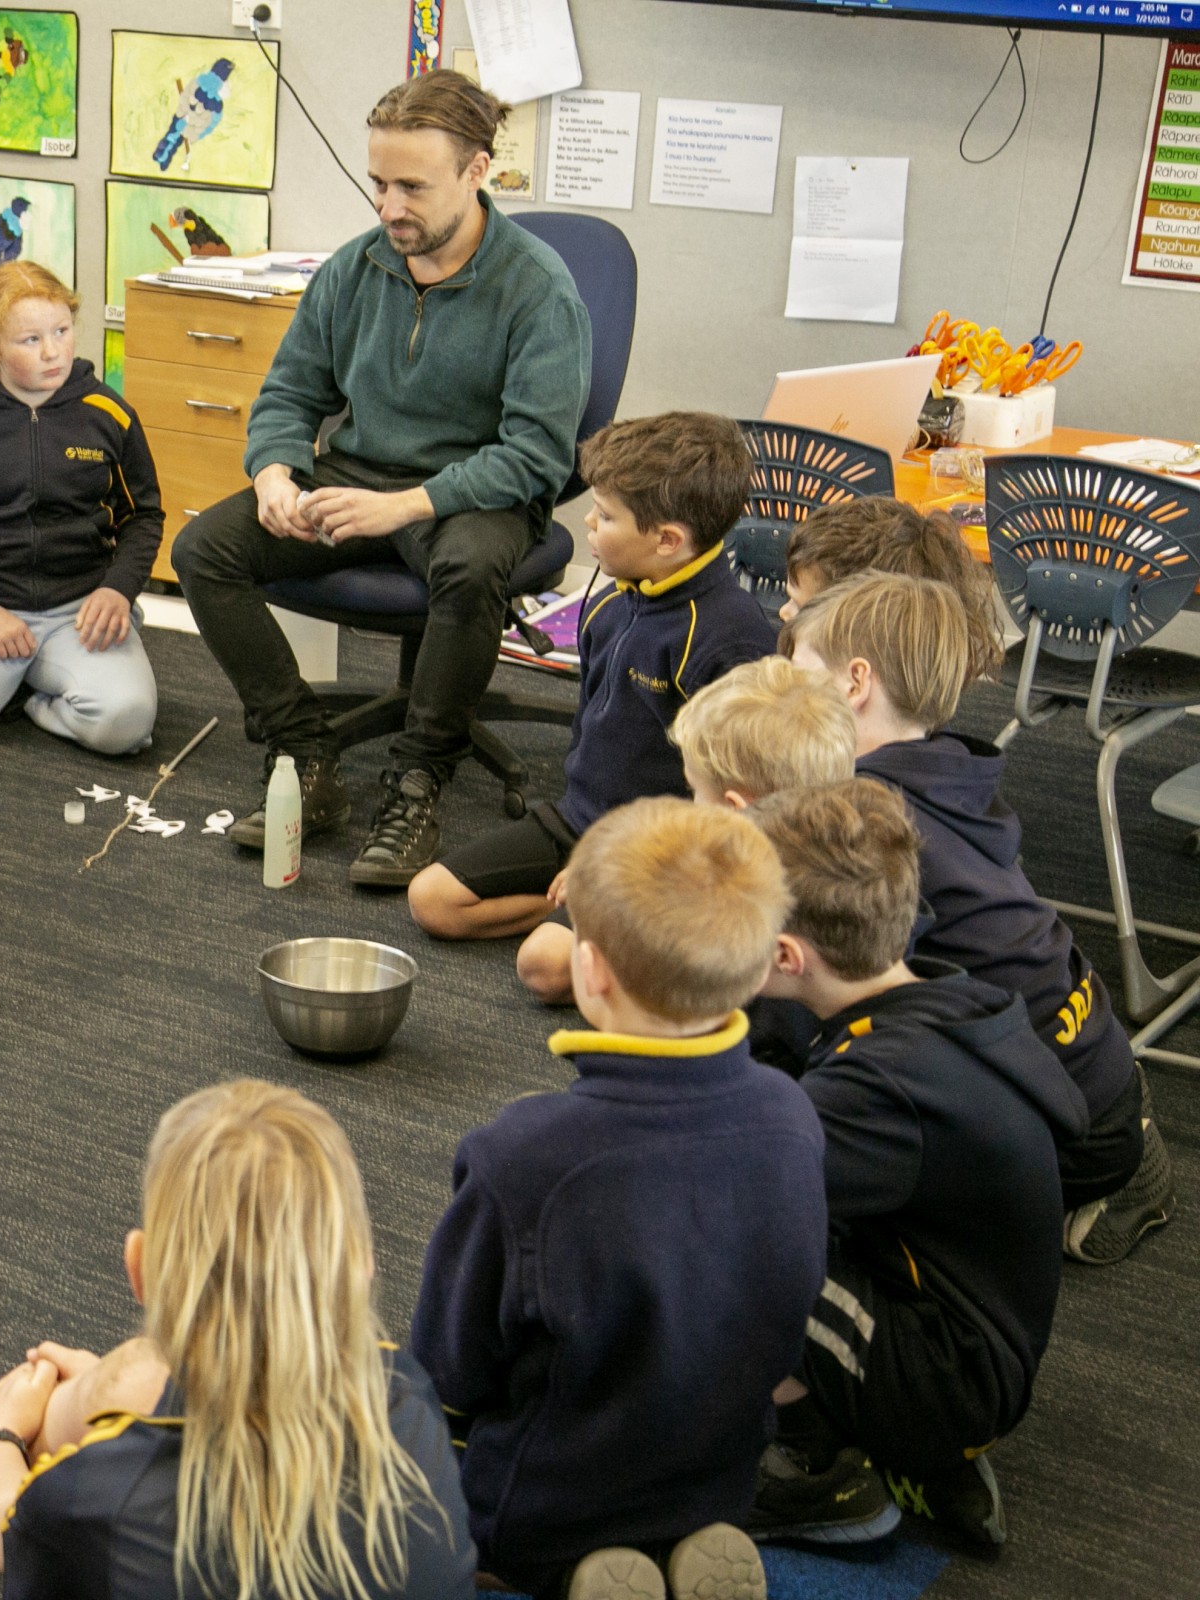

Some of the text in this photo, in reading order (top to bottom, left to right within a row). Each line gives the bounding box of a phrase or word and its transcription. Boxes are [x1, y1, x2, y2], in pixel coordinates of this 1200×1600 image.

[1115, 7, 1130, 16] ENG
[1140, 4, 1168, 13] 2:05 PM
[1136, 14, 1170, 24] 7/21/2023
